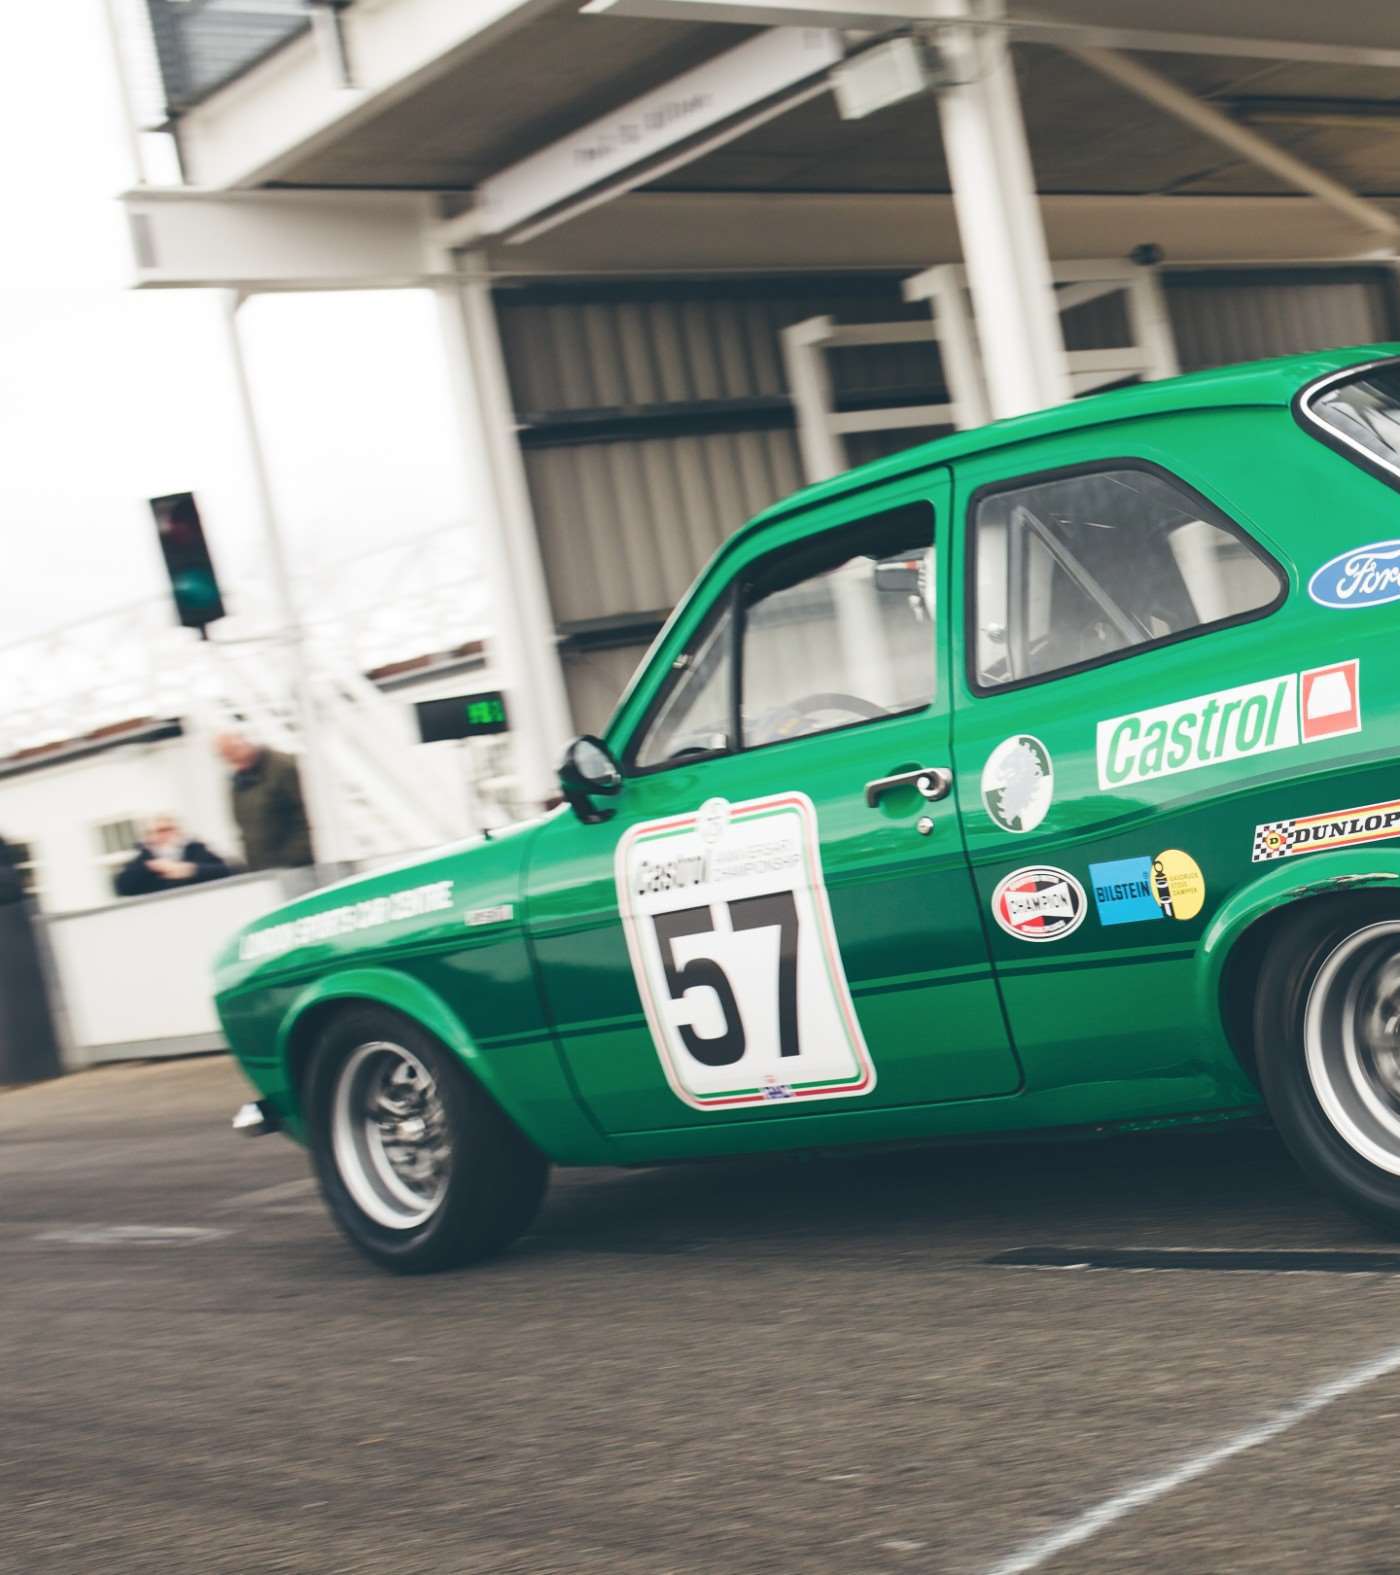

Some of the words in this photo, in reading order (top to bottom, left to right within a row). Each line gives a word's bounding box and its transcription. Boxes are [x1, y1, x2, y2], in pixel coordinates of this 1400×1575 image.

[1105, 681, 1288, 784] Castrol
[1269, 836, 1279, 845] D
[1096, 880, 1150, 903] BILSTEIN
[1010, 892, 1069, 916] CHAMPION
[652, 890, 800, 1067] 57
